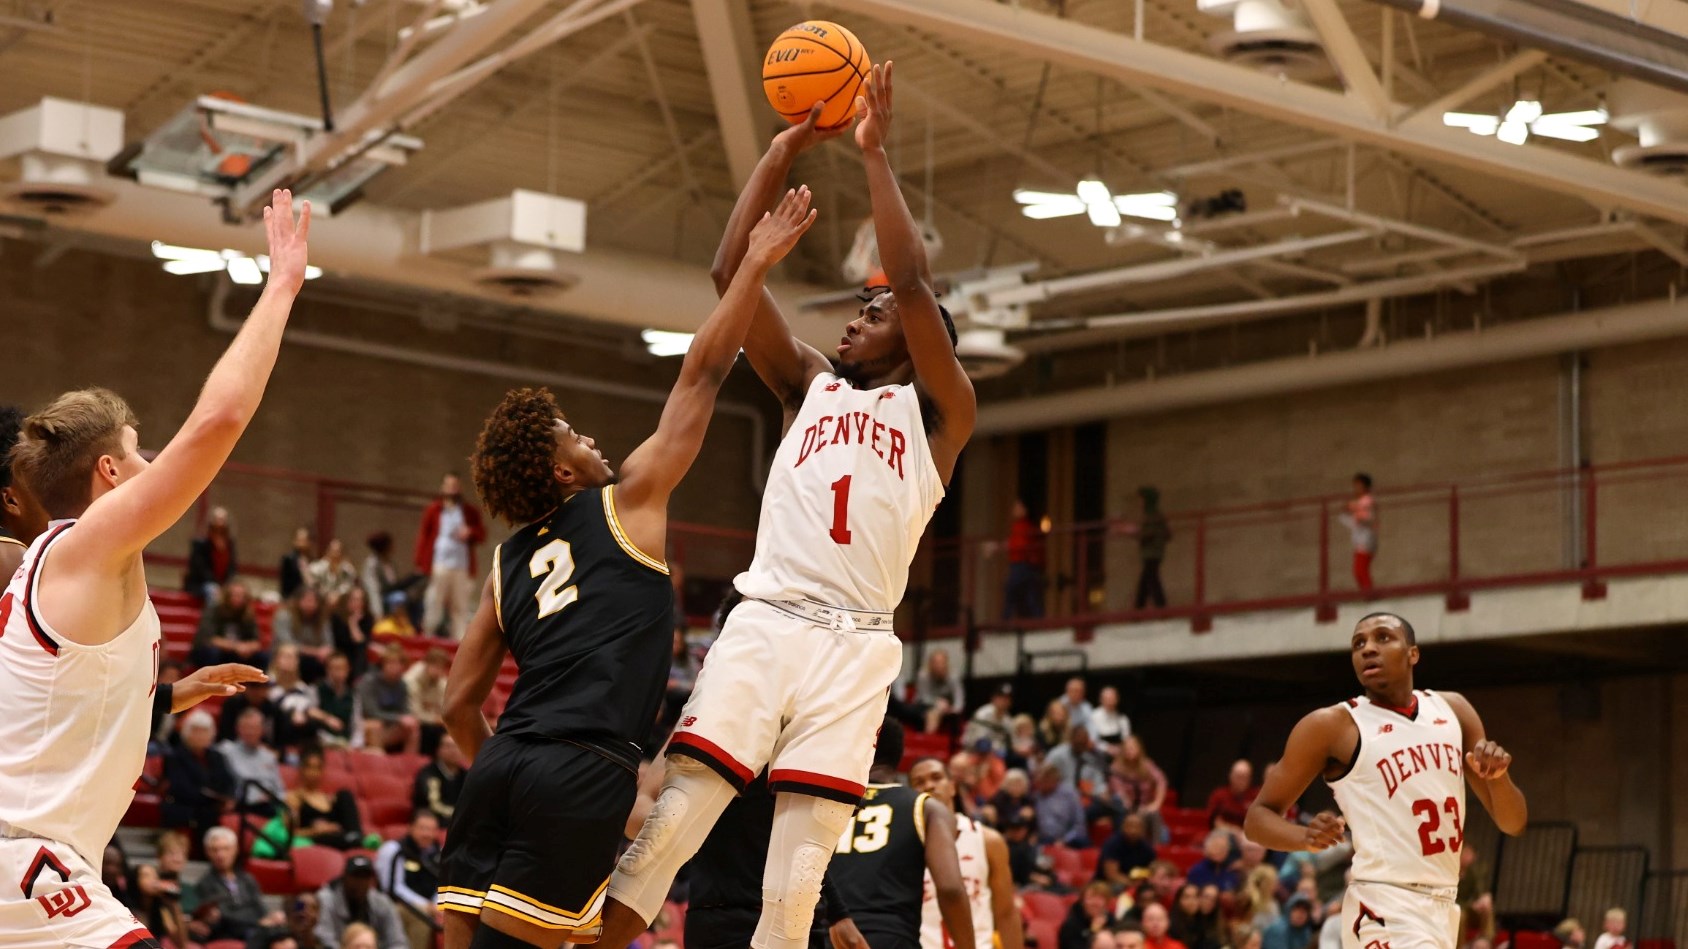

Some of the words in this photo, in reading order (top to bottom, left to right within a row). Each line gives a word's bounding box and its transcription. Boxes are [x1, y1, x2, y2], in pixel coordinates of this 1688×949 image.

[767, 48, 800, 65] EVO
[794, 411, 906, 481] DENVER
[829, 474, 852, 545] 1
[529, 538, 578, 620] 2
[1411, 796, 1463, 857] 23
[35, 884, 92, 920] DU
